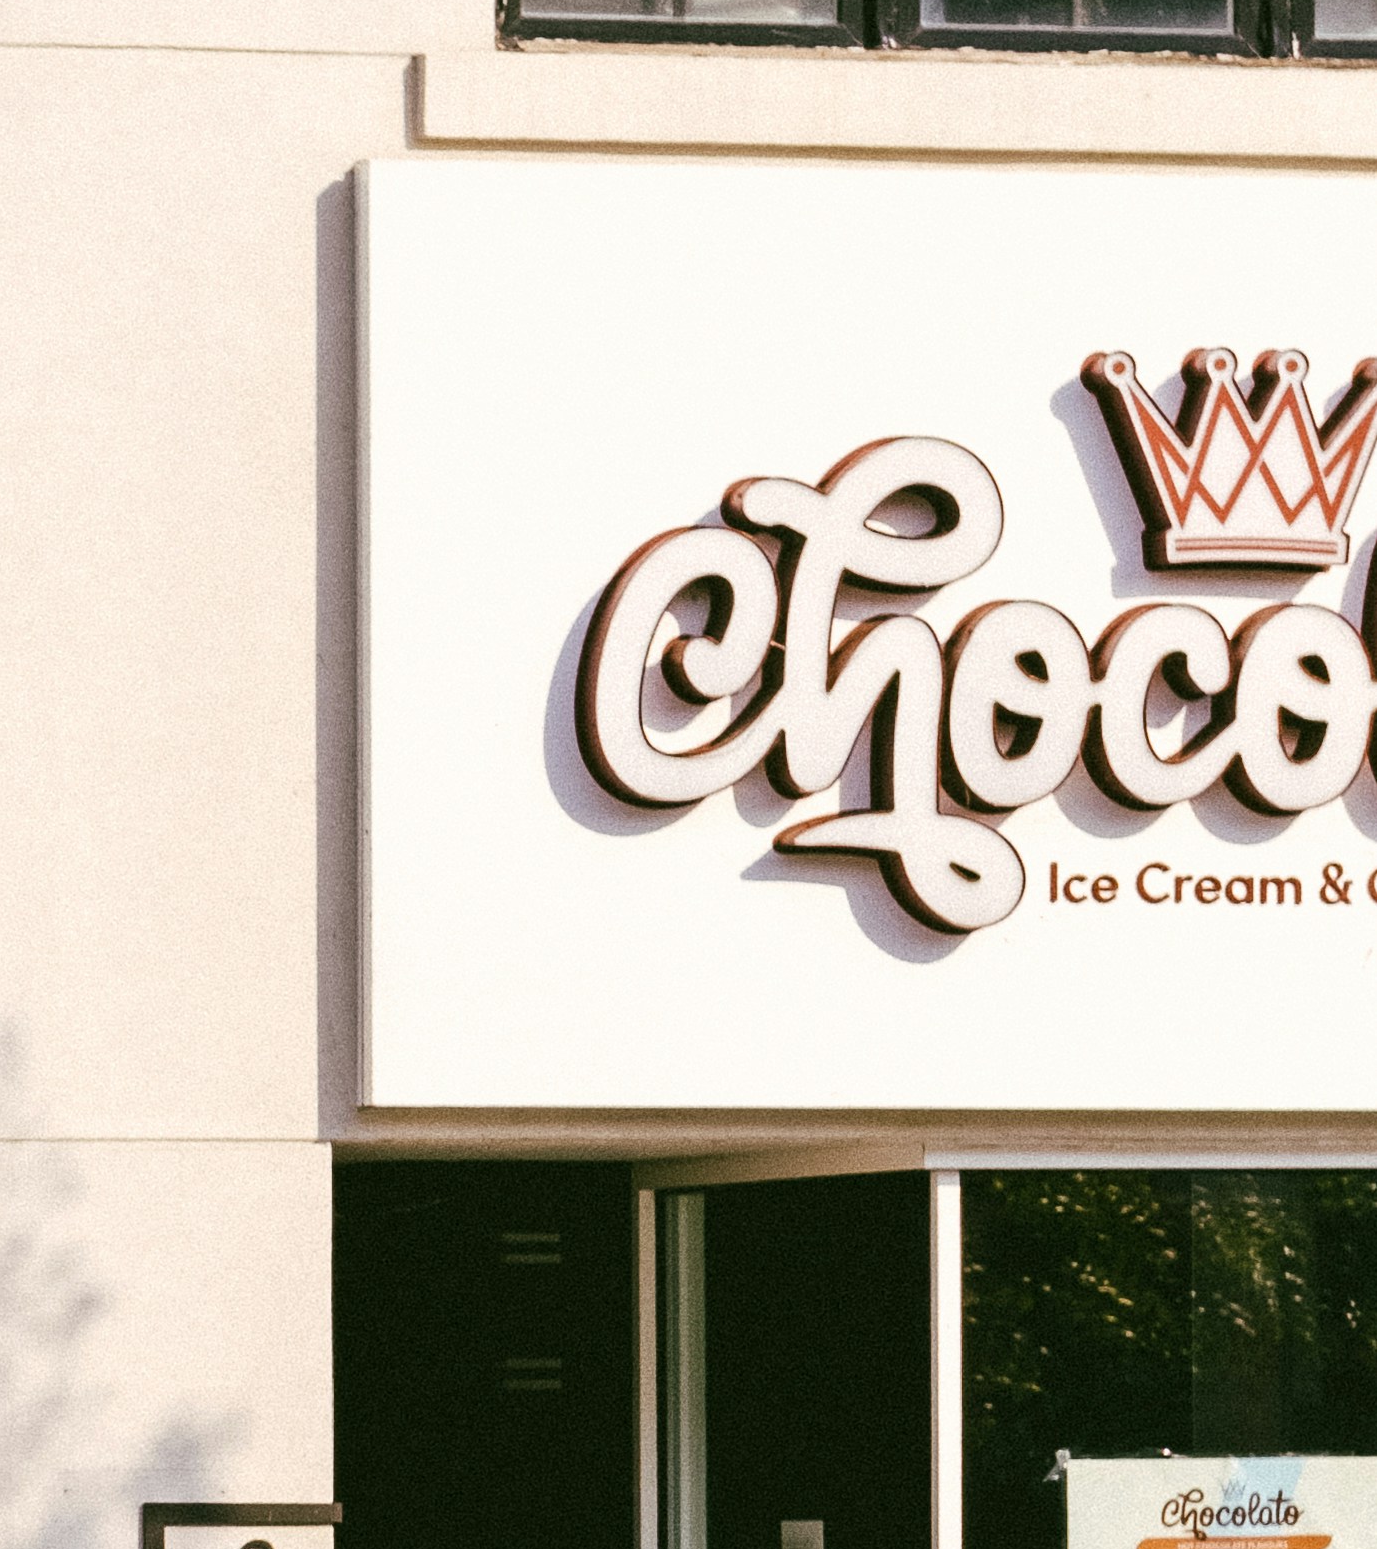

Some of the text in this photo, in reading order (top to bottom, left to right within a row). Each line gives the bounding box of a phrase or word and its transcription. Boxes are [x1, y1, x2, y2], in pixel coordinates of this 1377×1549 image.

[574, 435, 1377, 936] Choco
[1049, 861, 1120, 904] Ice
[1135, 861, 1303, 905] Cream
[1319, 861, 1354, 905] &
[1161, 1487, 1305, 1541] Chocolato
